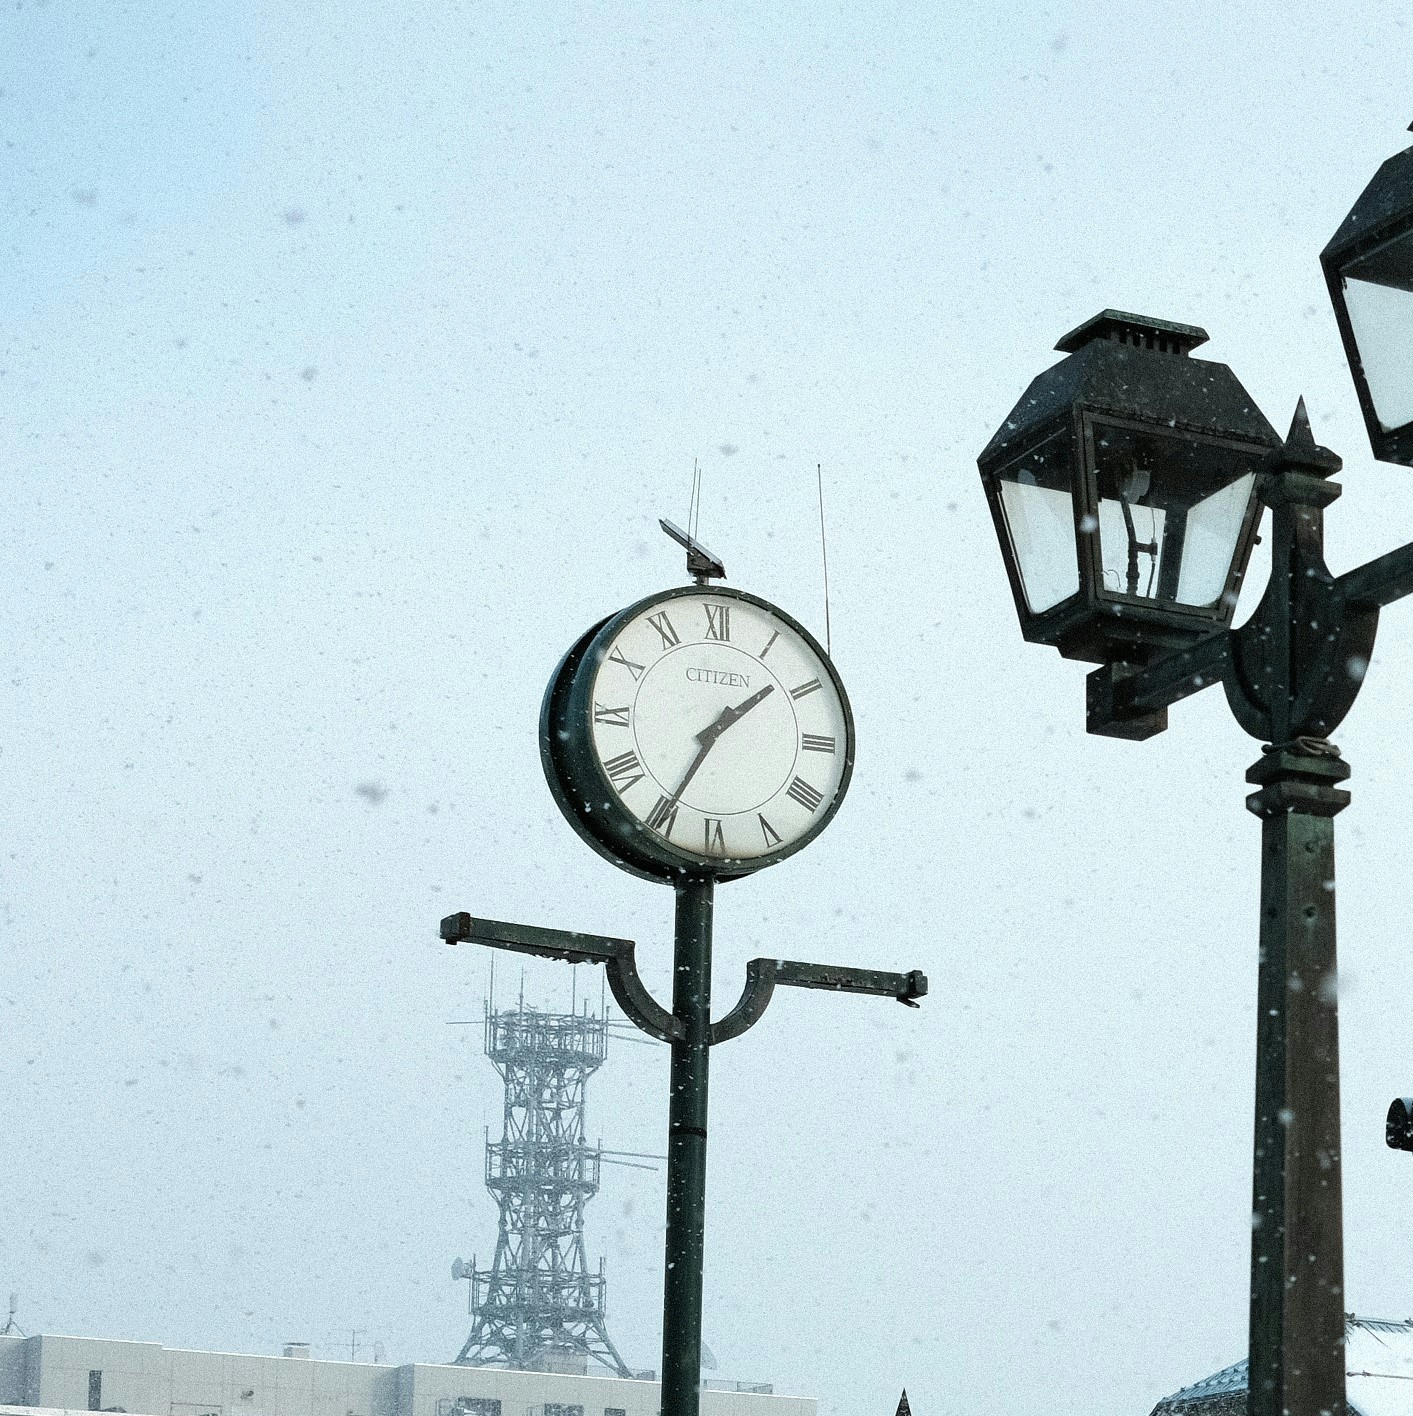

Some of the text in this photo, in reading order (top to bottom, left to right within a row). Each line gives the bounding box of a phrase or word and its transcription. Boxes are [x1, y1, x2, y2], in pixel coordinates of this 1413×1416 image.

[645, 611, 682, 651] XI
[703, 603, 730, 642] XII
[759, 629, 780, 660] I
[608, 645, 646, 681] X
[686, 667, 751, 689] CITIZEN
[789, 677, 823, 700] II
[802, 732, 836, 755] III
[602, 750, 646, 795] VIII
[758, 813, 783, 848] V
